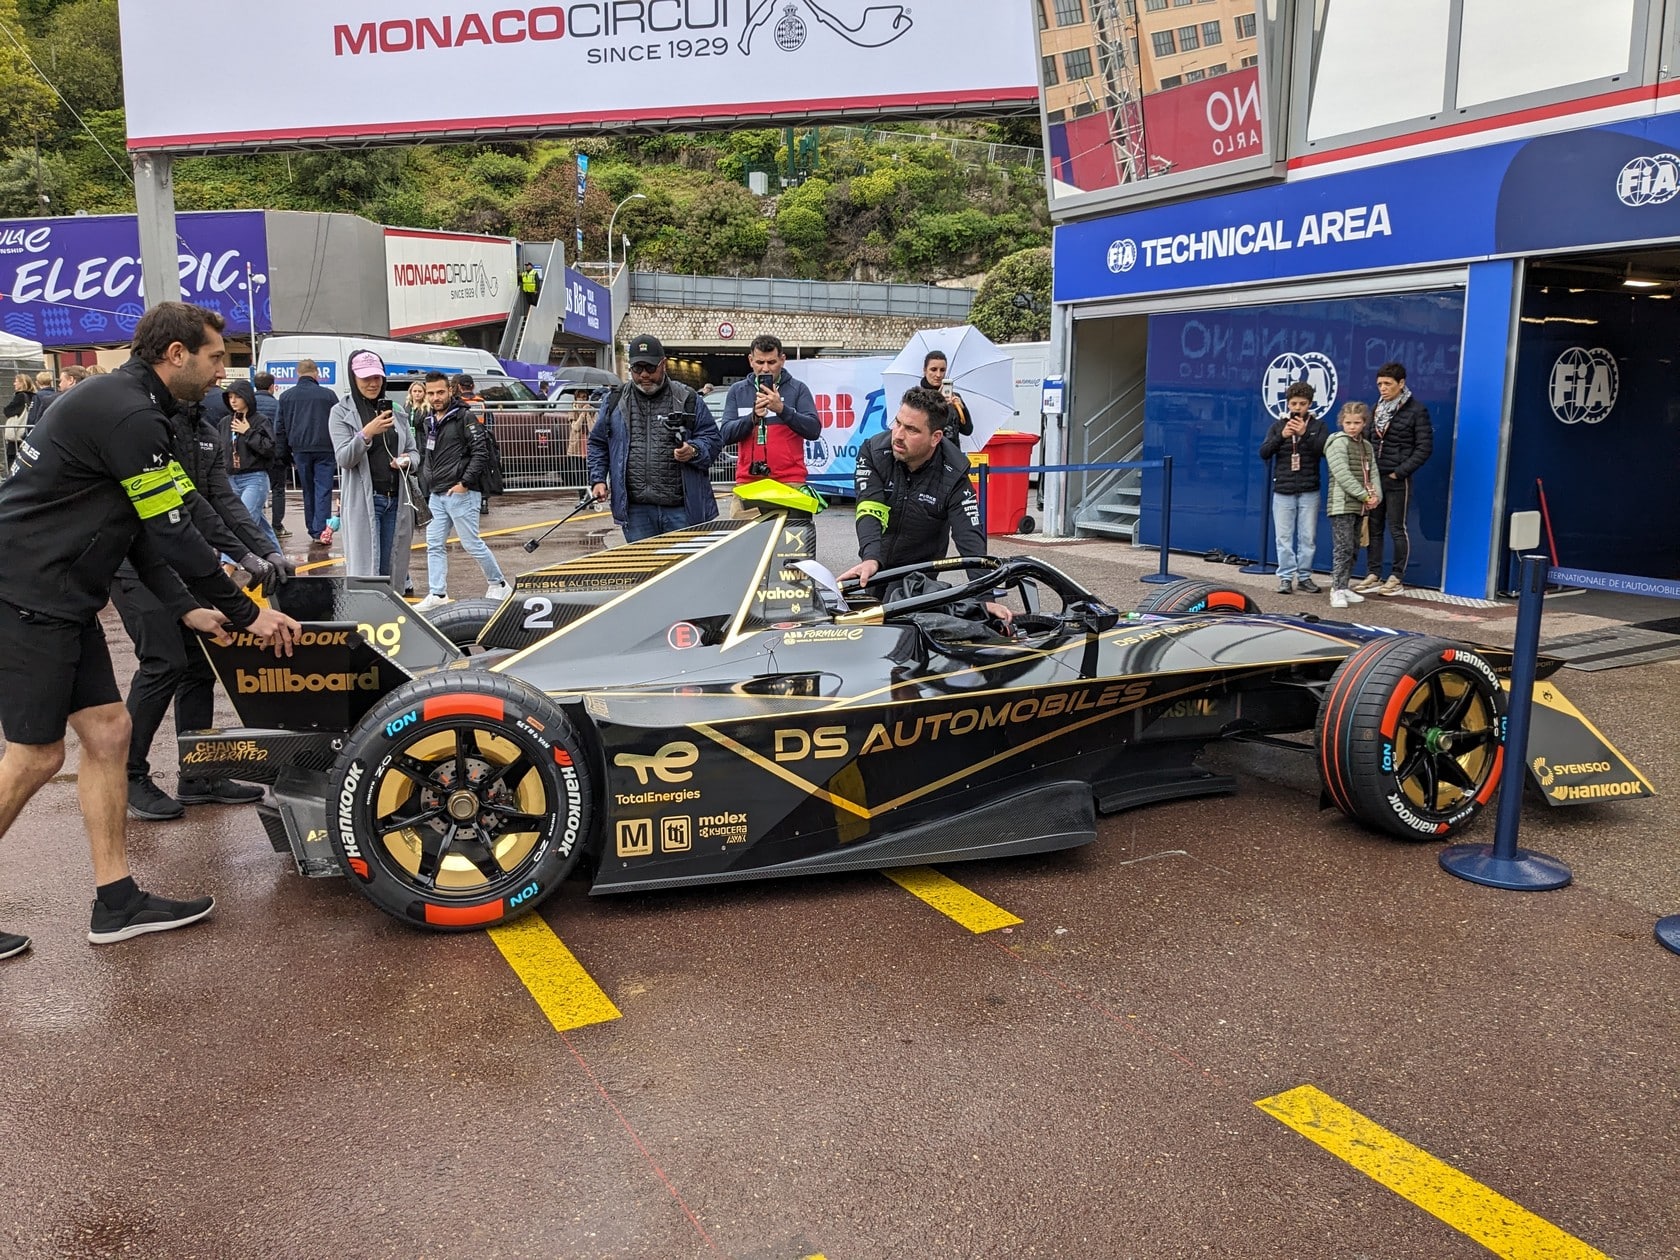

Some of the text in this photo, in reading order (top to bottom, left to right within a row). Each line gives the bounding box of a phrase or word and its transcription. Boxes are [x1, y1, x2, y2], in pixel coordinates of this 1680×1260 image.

[587, 37, 729, 64] SINCE 1929
[1141, 219, 1292, 268] TECHNICAL
[1297, 203, 1392, 248] AREA
[451, 288, 475, 300] SINCE 1929
[573, 281, 587, 317] Bär
[270, 367, 296, 378] RENT
[815, 394, 855, 428] BB
[516, 581, 566, 590] PENSKE
[1608, 578, 1620, 588] DE
[757, 586, 814, 603] yahoo!
[523, 597, 554, 629] 2
[675, 626, 692, 647] E
[803, 629, 849, 638] FORMULA
[236, 667, 380, 694] billboard
[774, 681, 1153, 762] DS AUTOMOBILES
[195, 740, 258, 753] CHANGE
[614, 789, 701, 806] TotalEnergies
[698, 811, 748, 827] molex
[621, 823, 648, 849] M
